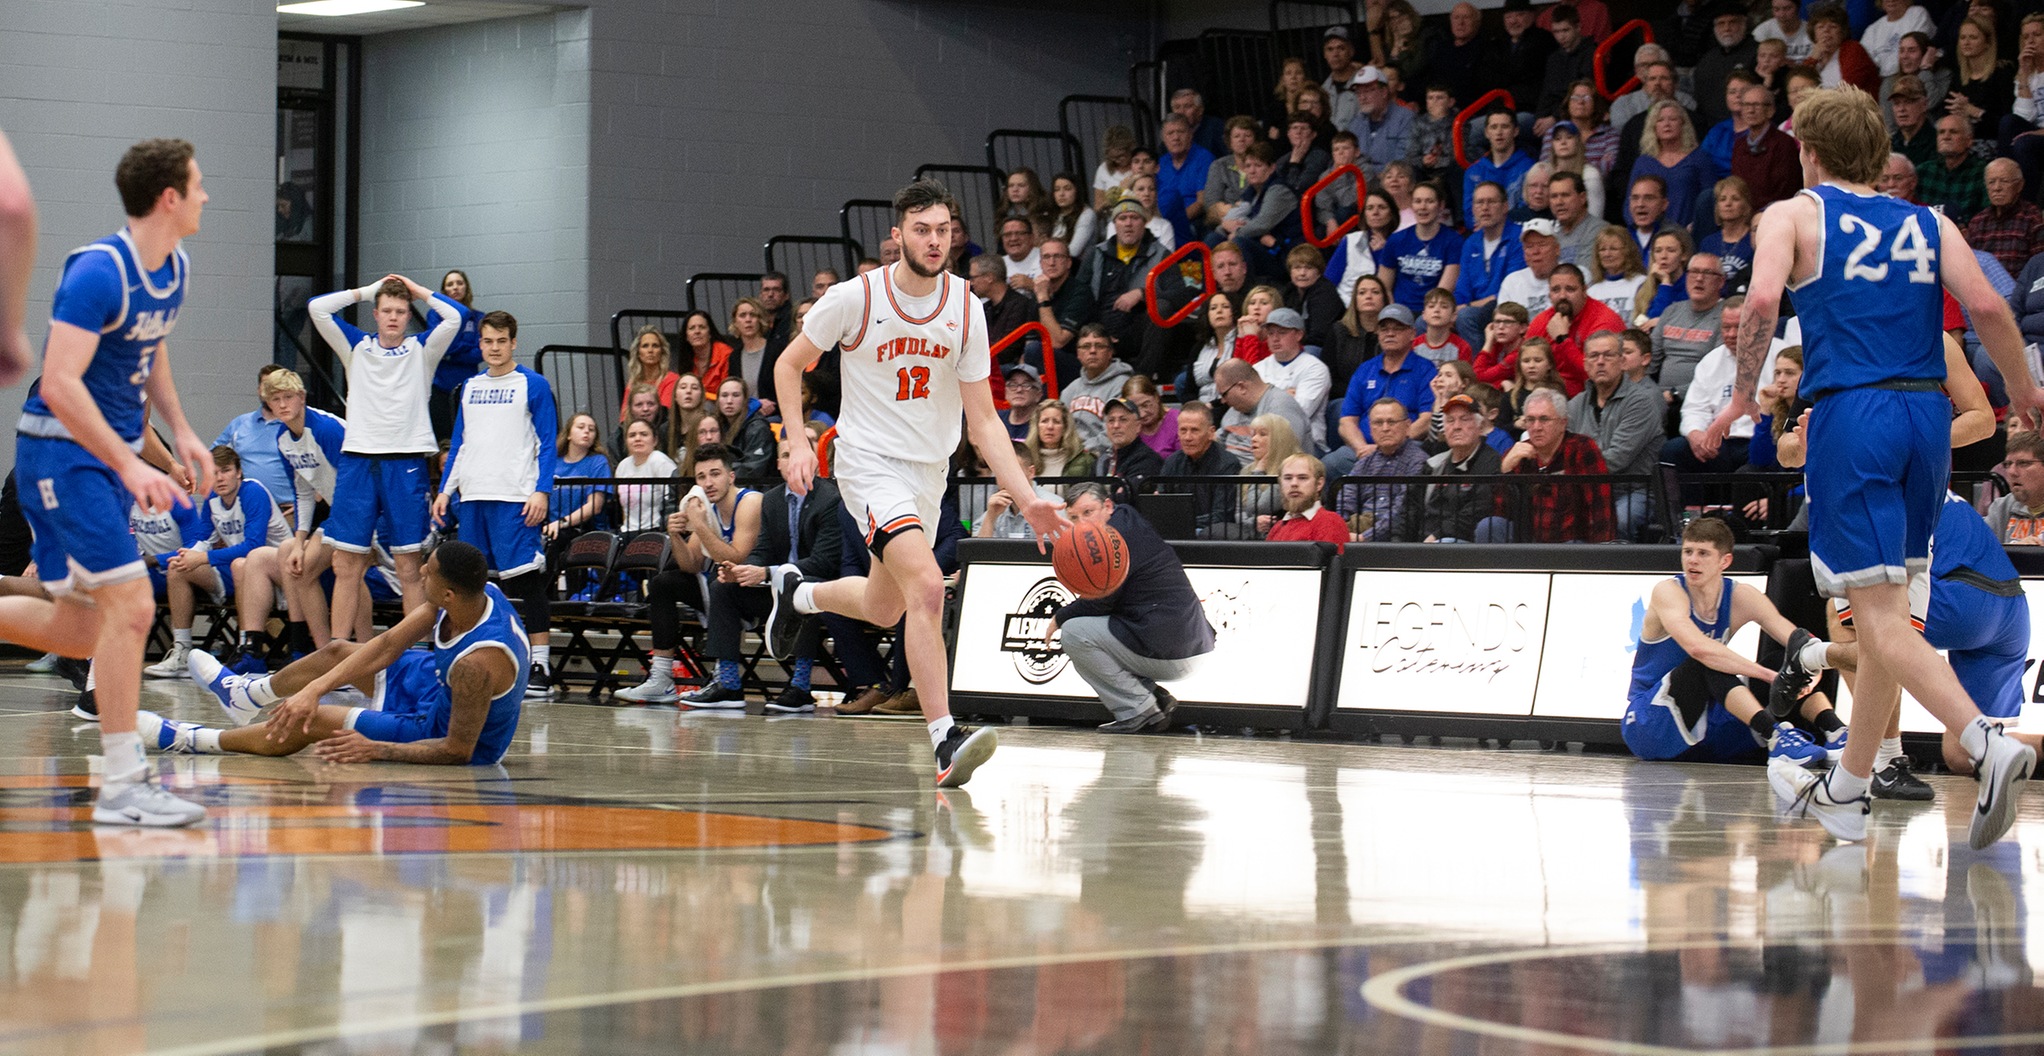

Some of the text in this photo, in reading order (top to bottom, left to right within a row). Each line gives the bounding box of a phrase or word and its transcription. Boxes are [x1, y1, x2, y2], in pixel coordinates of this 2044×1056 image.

[1839, 213, 1936, 284] 24
[876, 336, 951, 363] FINDLAY
[469, 388, 516, 405] HILLSDALE
[896, 365, 931, 401] 12
[1083, 529, 1104, 567] NCAA
[1359, 601, 1529, 653] LEGENDS
